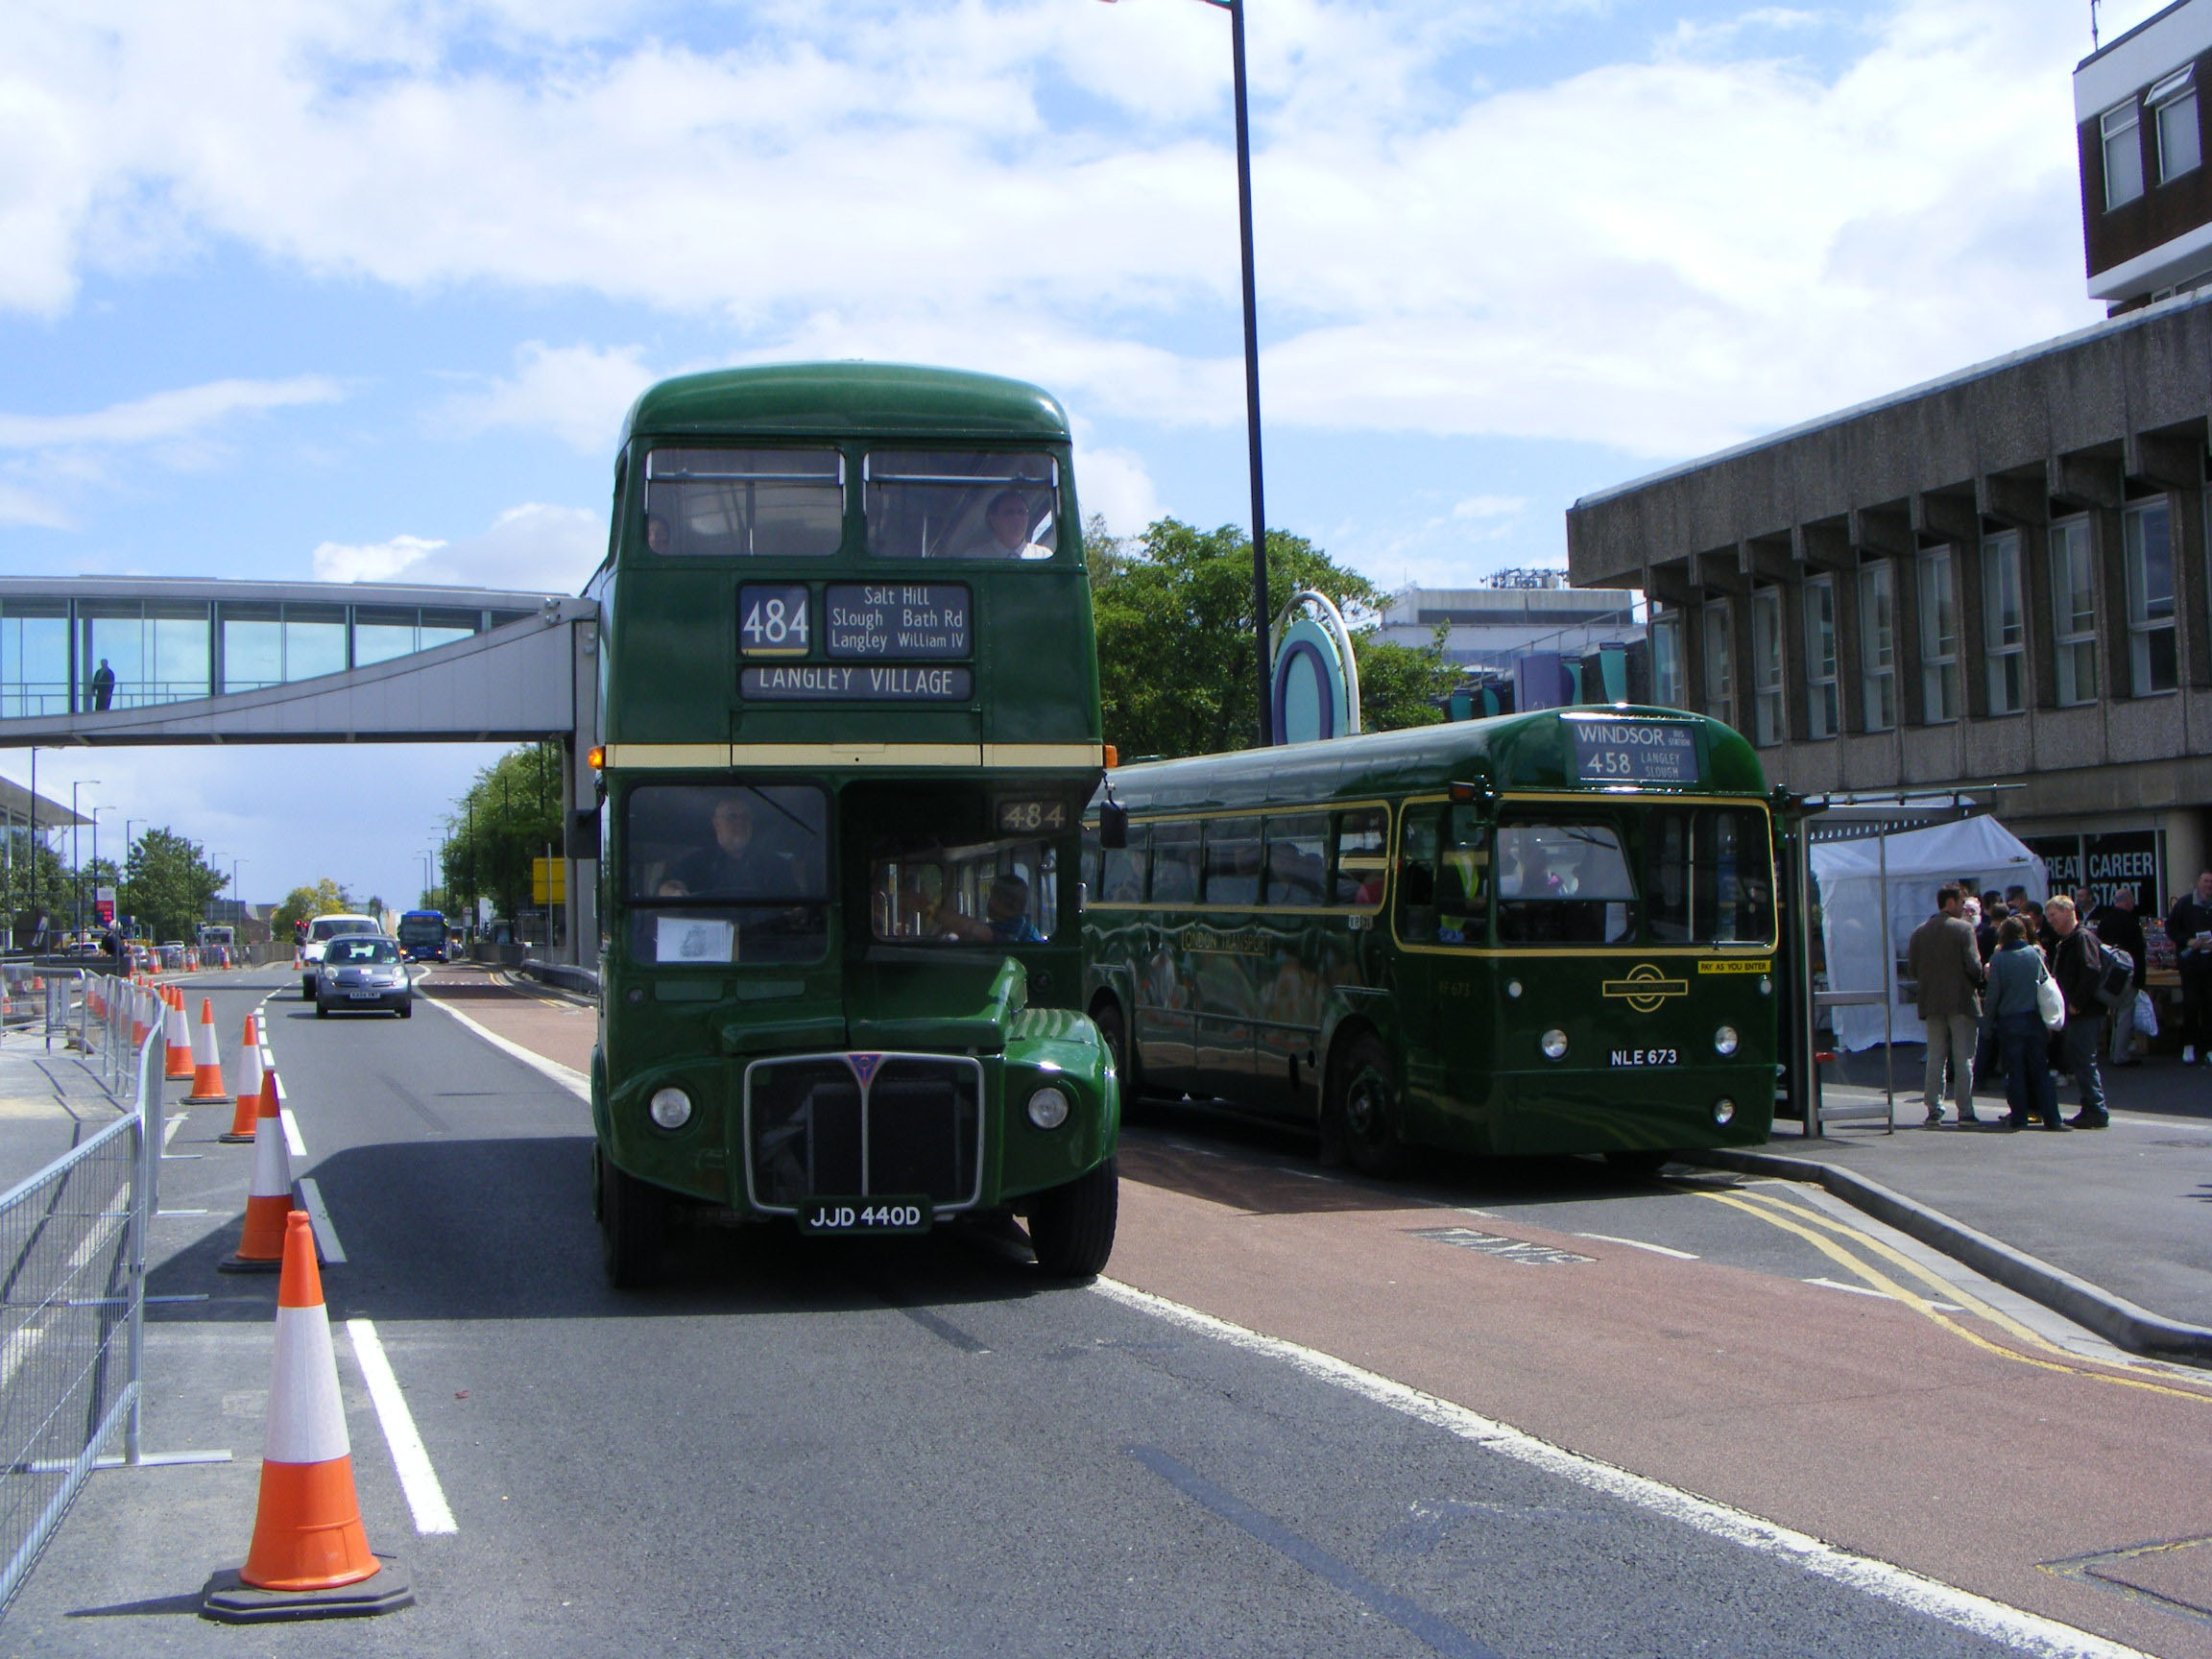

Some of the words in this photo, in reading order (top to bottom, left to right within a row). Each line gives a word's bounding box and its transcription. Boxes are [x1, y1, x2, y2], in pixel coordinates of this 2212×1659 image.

[863, 587, 895, 605] Salt
[902, 587, 929, 605] Hill
[743, 599, 809, 643] 484
[832, 608, 883, 631] Slough
[902, 609, 938, 627] Bath
[945, 610, 963, 628] Rd
[831, 630, 888, 653] Langley
[898, 633, 947, 648] William
[951, 633, 964, 648] IV
[759, 667, 853, 691] LANGLEY
[871, 667, 953, 694] VILLAGE
[1577, 725, 1666, 746] WINDSOR
[1588, 752, 1631, 774] 458
[1641, 752, 1681, 766] LANGLEY
[1645, 765, 1679, 778] SLOUGH
[1004, 803, 1066, 828] 484
[2045, 855, 2080, 879] REAT
[2089, 852, 2153, 878] CAREER
[1182, 929, 1218, 950] LONDON
[1221, 932, 1273, 954] TRANSPORT
[1744, 962, 1767, 971] ENTER
[1611, 1049, 1644, 1066] NLE
[1647, 1048, 1677, 1065] 673
[810, 1207, 855, 1227] JJD
[859, 1206, 921, 1226] 440D
